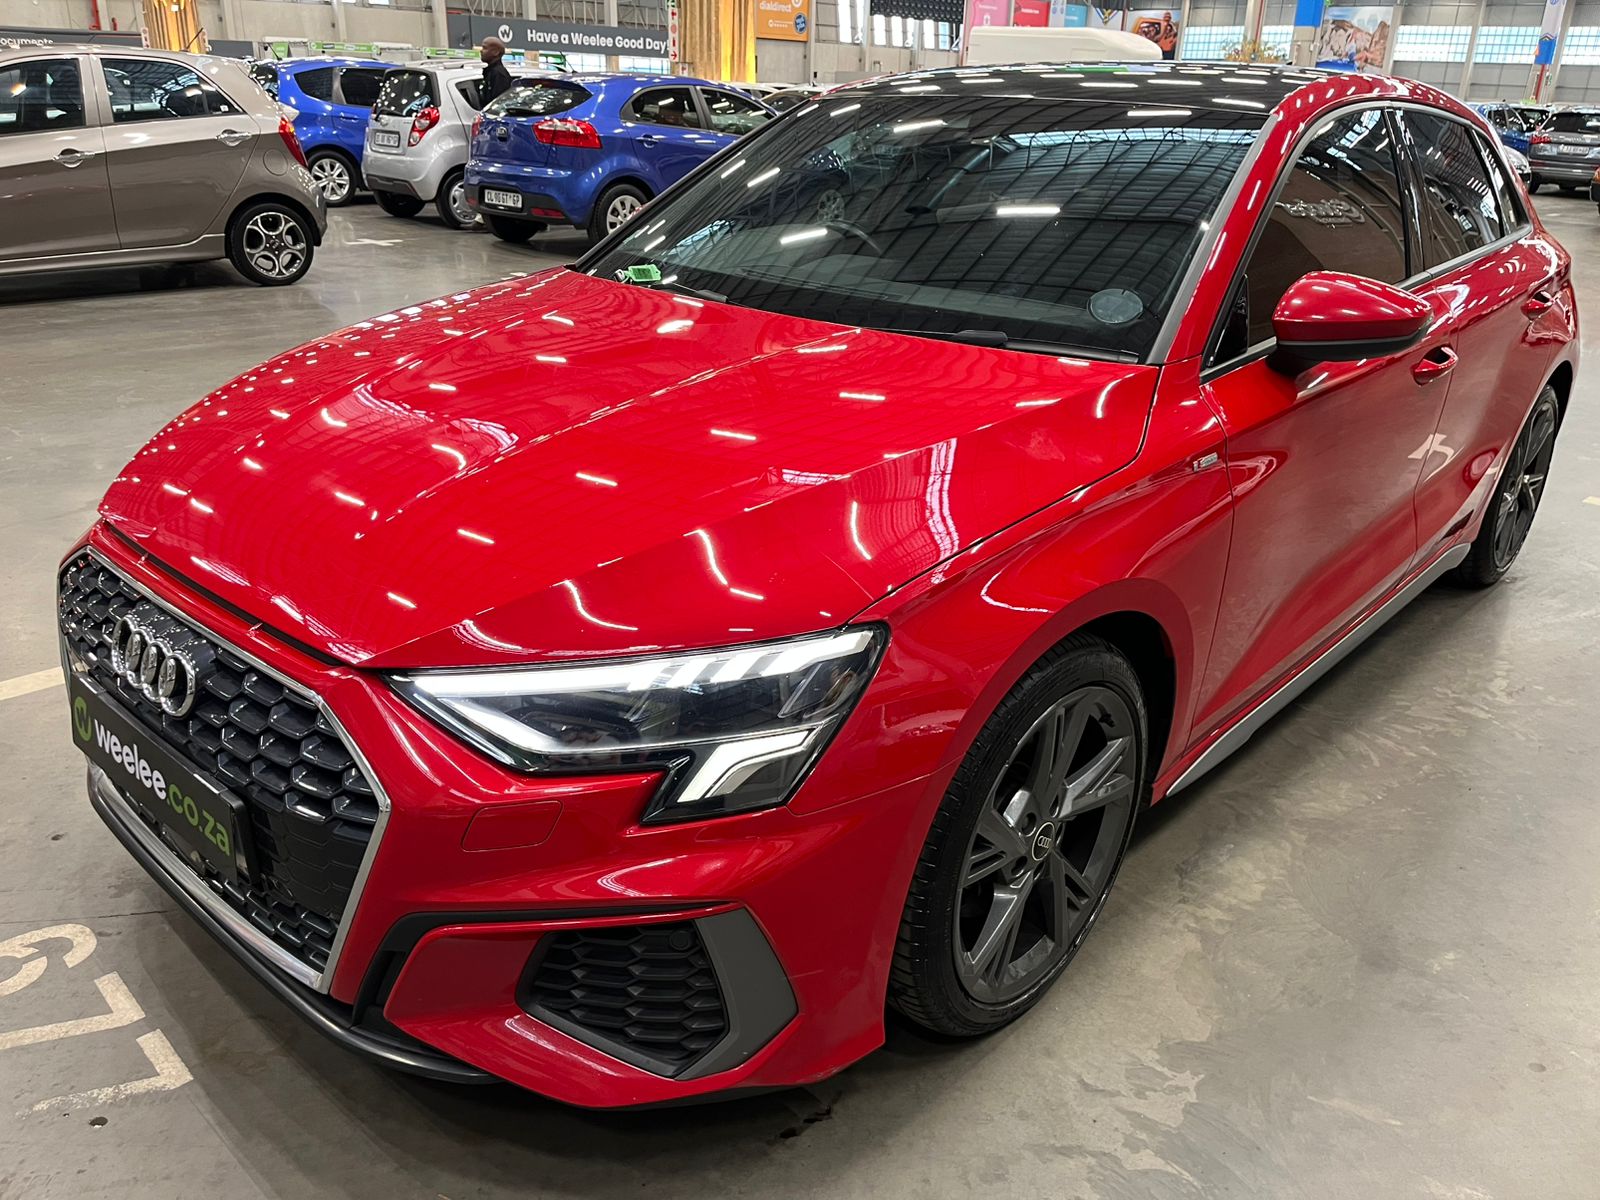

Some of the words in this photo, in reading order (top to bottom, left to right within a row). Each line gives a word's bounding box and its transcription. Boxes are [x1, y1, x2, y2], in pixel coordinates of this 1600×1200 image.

[527, 29, 559, 43] Have
[561, 33, 569, 44] a
[571, 32, 613, 47] Weelee
[615, 36, 644, 49] Good
[94, 719, 230, 856] weelee.co.za
